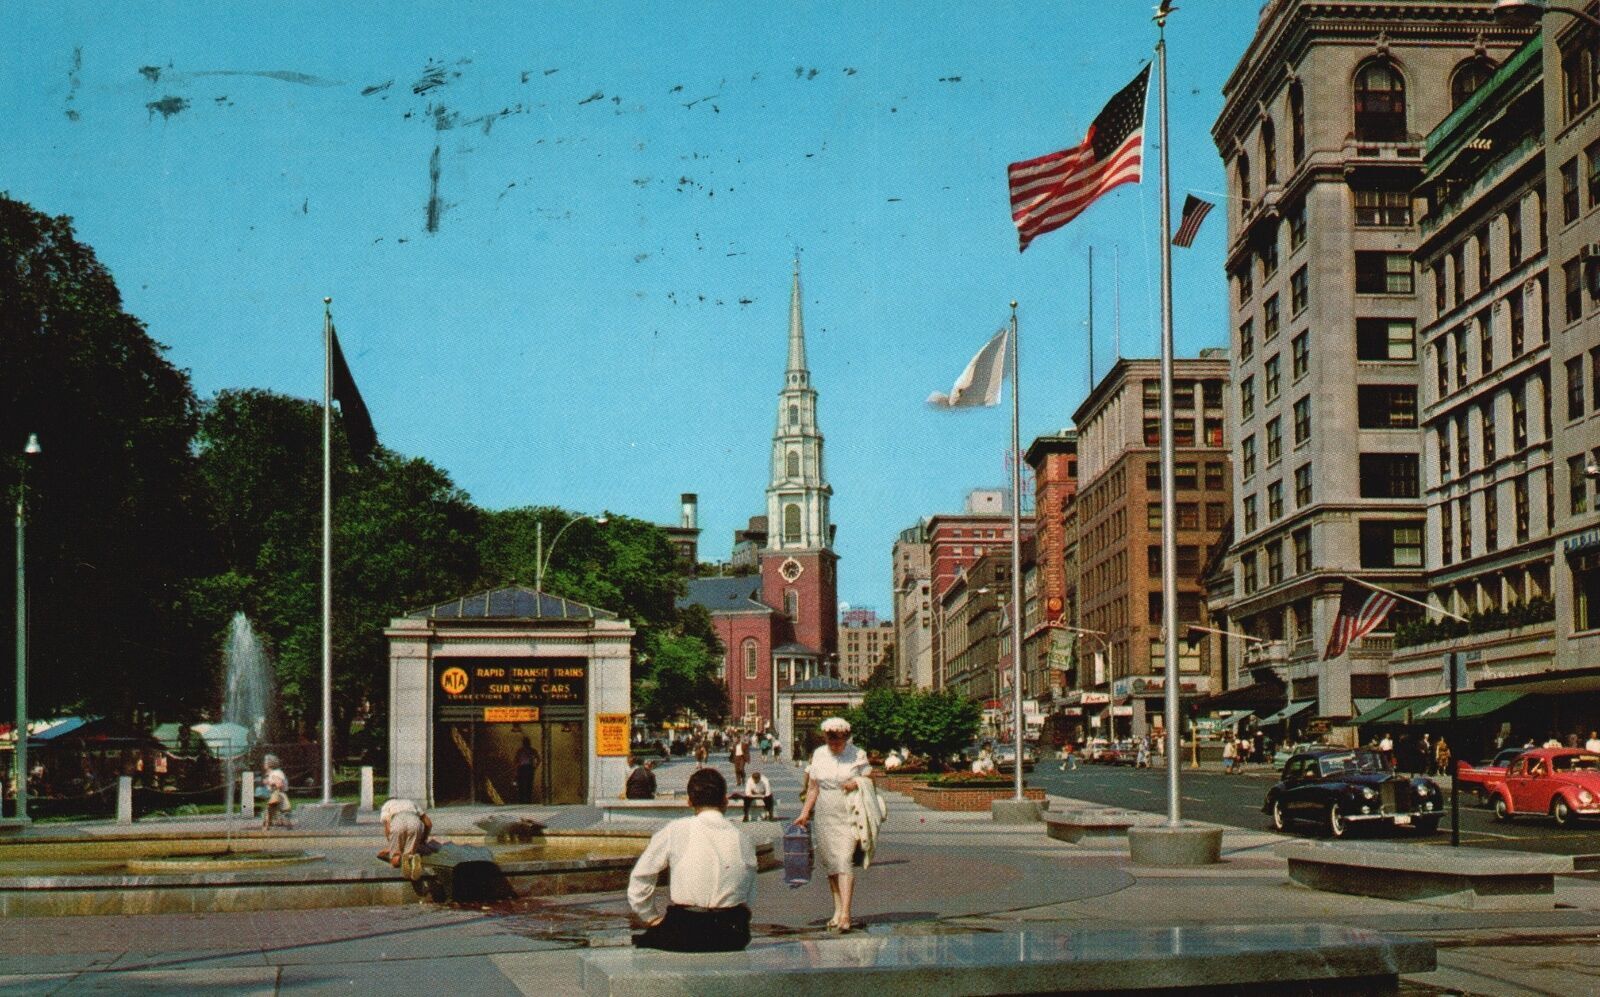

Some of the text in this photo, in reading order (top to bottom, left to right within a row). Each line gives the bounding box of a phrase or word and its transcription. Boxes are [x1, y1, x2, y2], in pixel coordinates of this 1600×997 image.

[476, 668, 584, 678] RAPID TRANSIT TRAINS
[443, 671, 466, 688] MTA
[542, 684, 571, 693] CARS
[599, 716, 628, 724] WARNING
